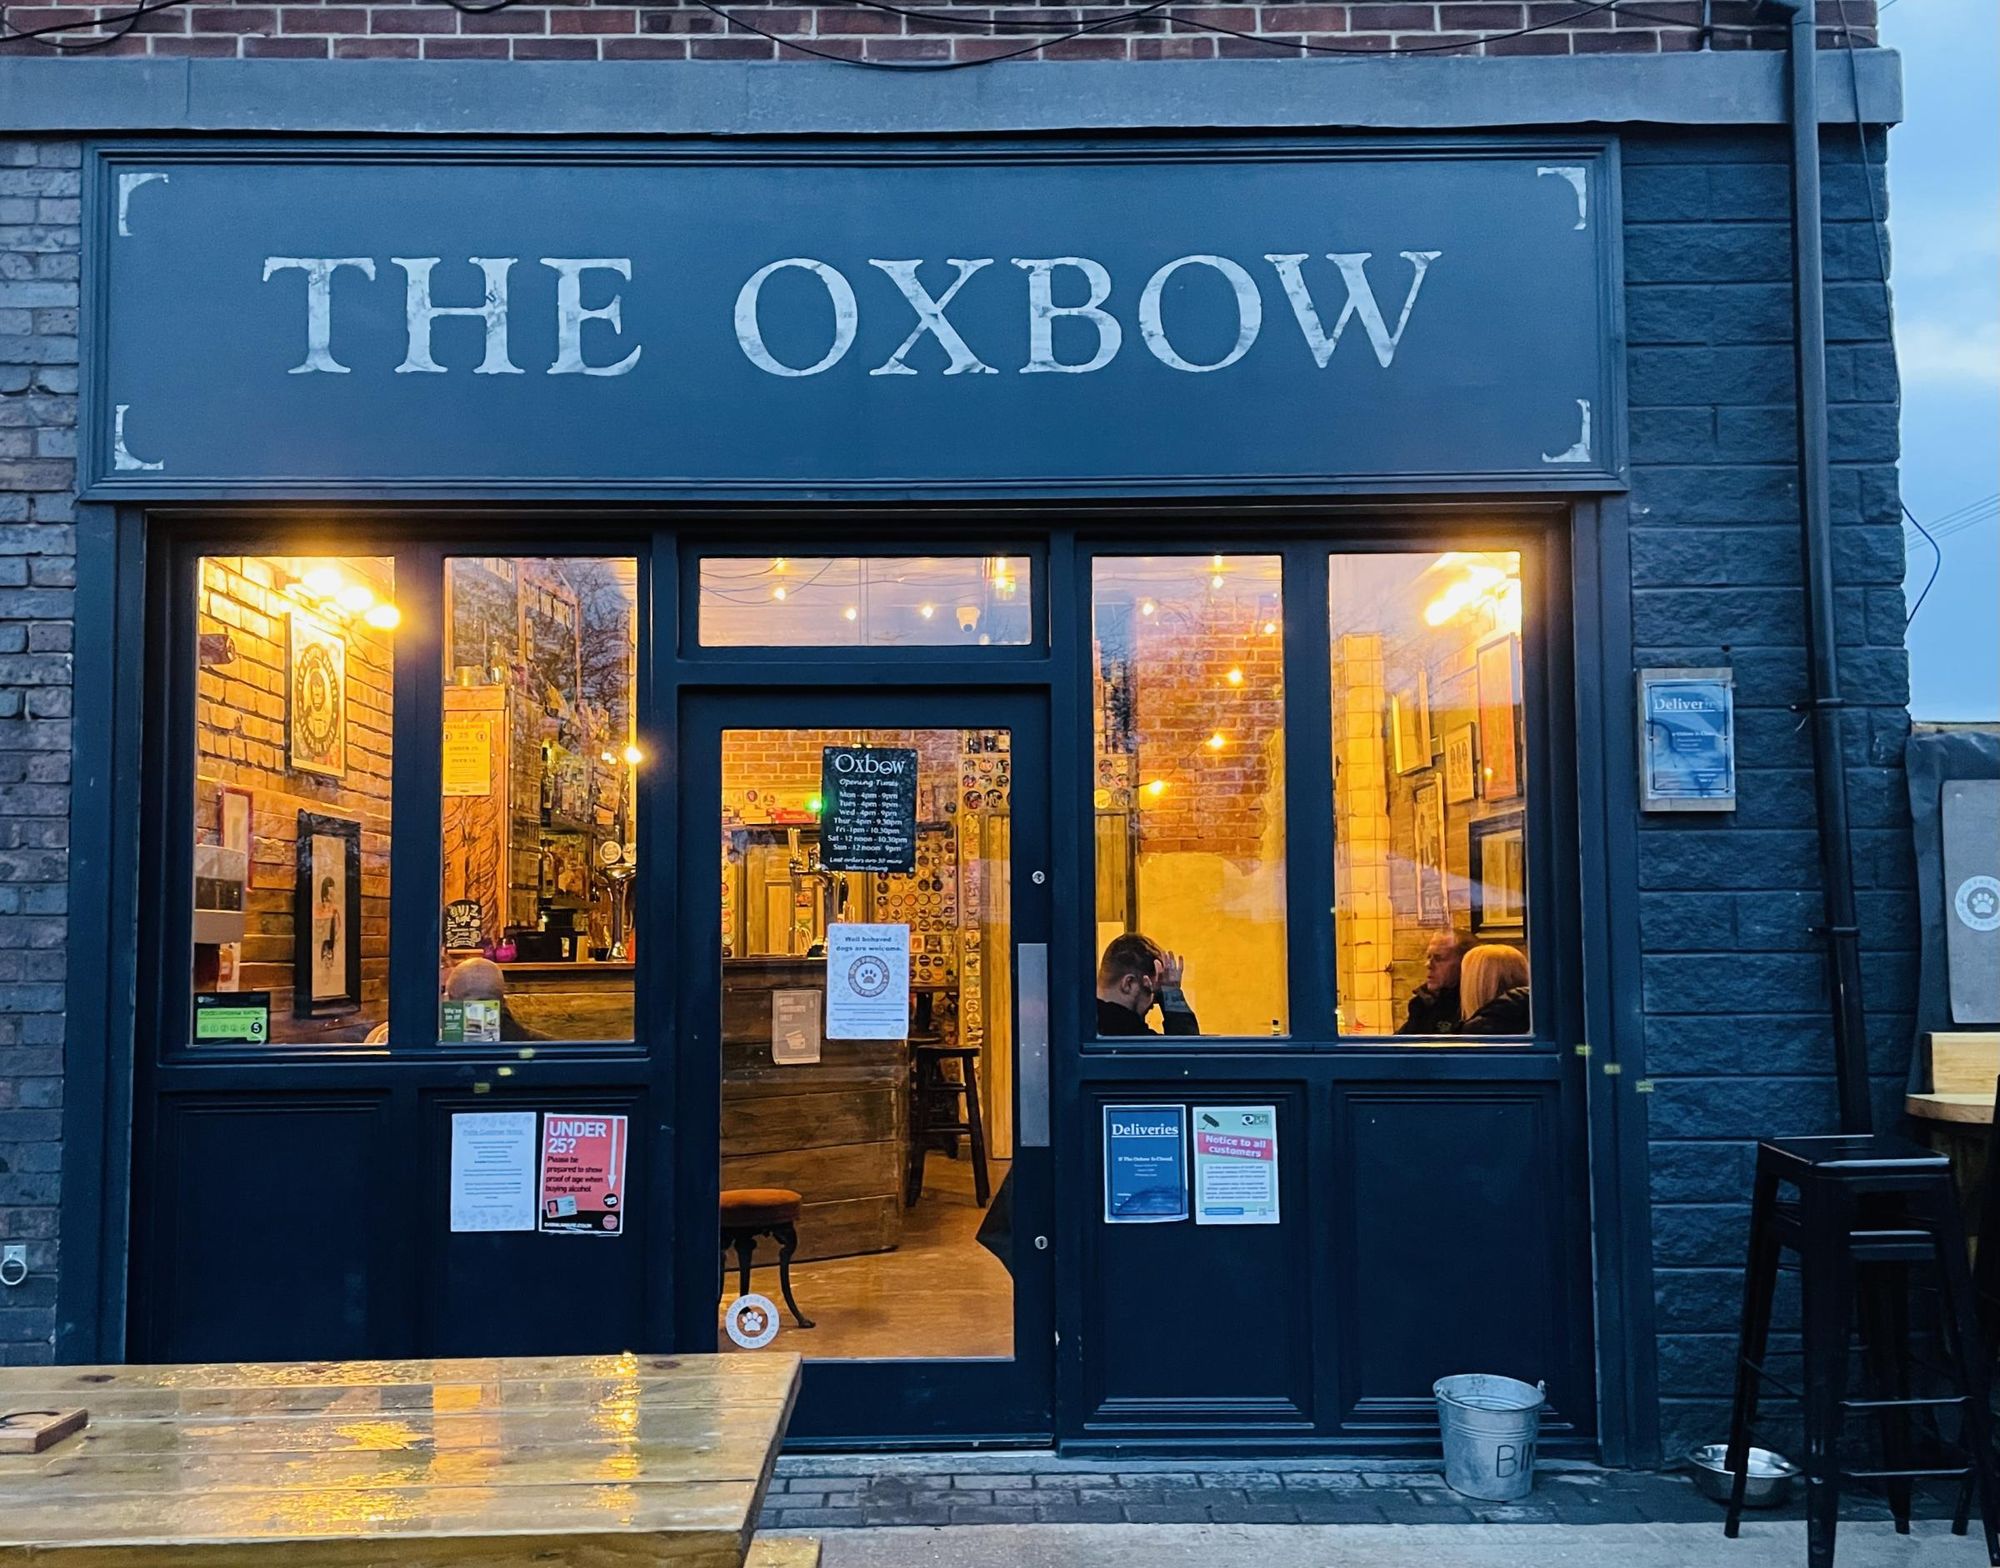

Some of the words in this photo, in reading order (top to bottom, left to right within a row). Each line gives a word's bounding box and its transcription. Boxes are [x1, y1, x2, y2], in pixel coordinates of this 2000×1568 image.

[262, 257, 642, 376] THE
[734, 250, 1443, 378] OXBOW
[835, 753, 906, 774] Oxbow
[839, 779, 873, 787] Opening
[881, 792, 898, 800] 9pm
[881, 801, 898, 809] 9pm
[885, 844, 902, 852] 9pm
[550, 1121, 606, 1138] UNDER
[1112, 1123, 1179, 1135] Deliveries
[548, 1138, 577, 1153] 25?
[1205, 1135, 1239, 1147] Notice
[1240, 1137, 1252, 1148] to
[1253, 1138, 1267, 1149] all
[1208, 1146, 1262, 1158] customers
[547, 1155, 569, 1163] Please
[546, 1165, 577, 1174] prepared
[546, 1175, 564, 1183] proof
[571, 1176, 584, 1184] age
[545, 1184, 567, 1193] buying
